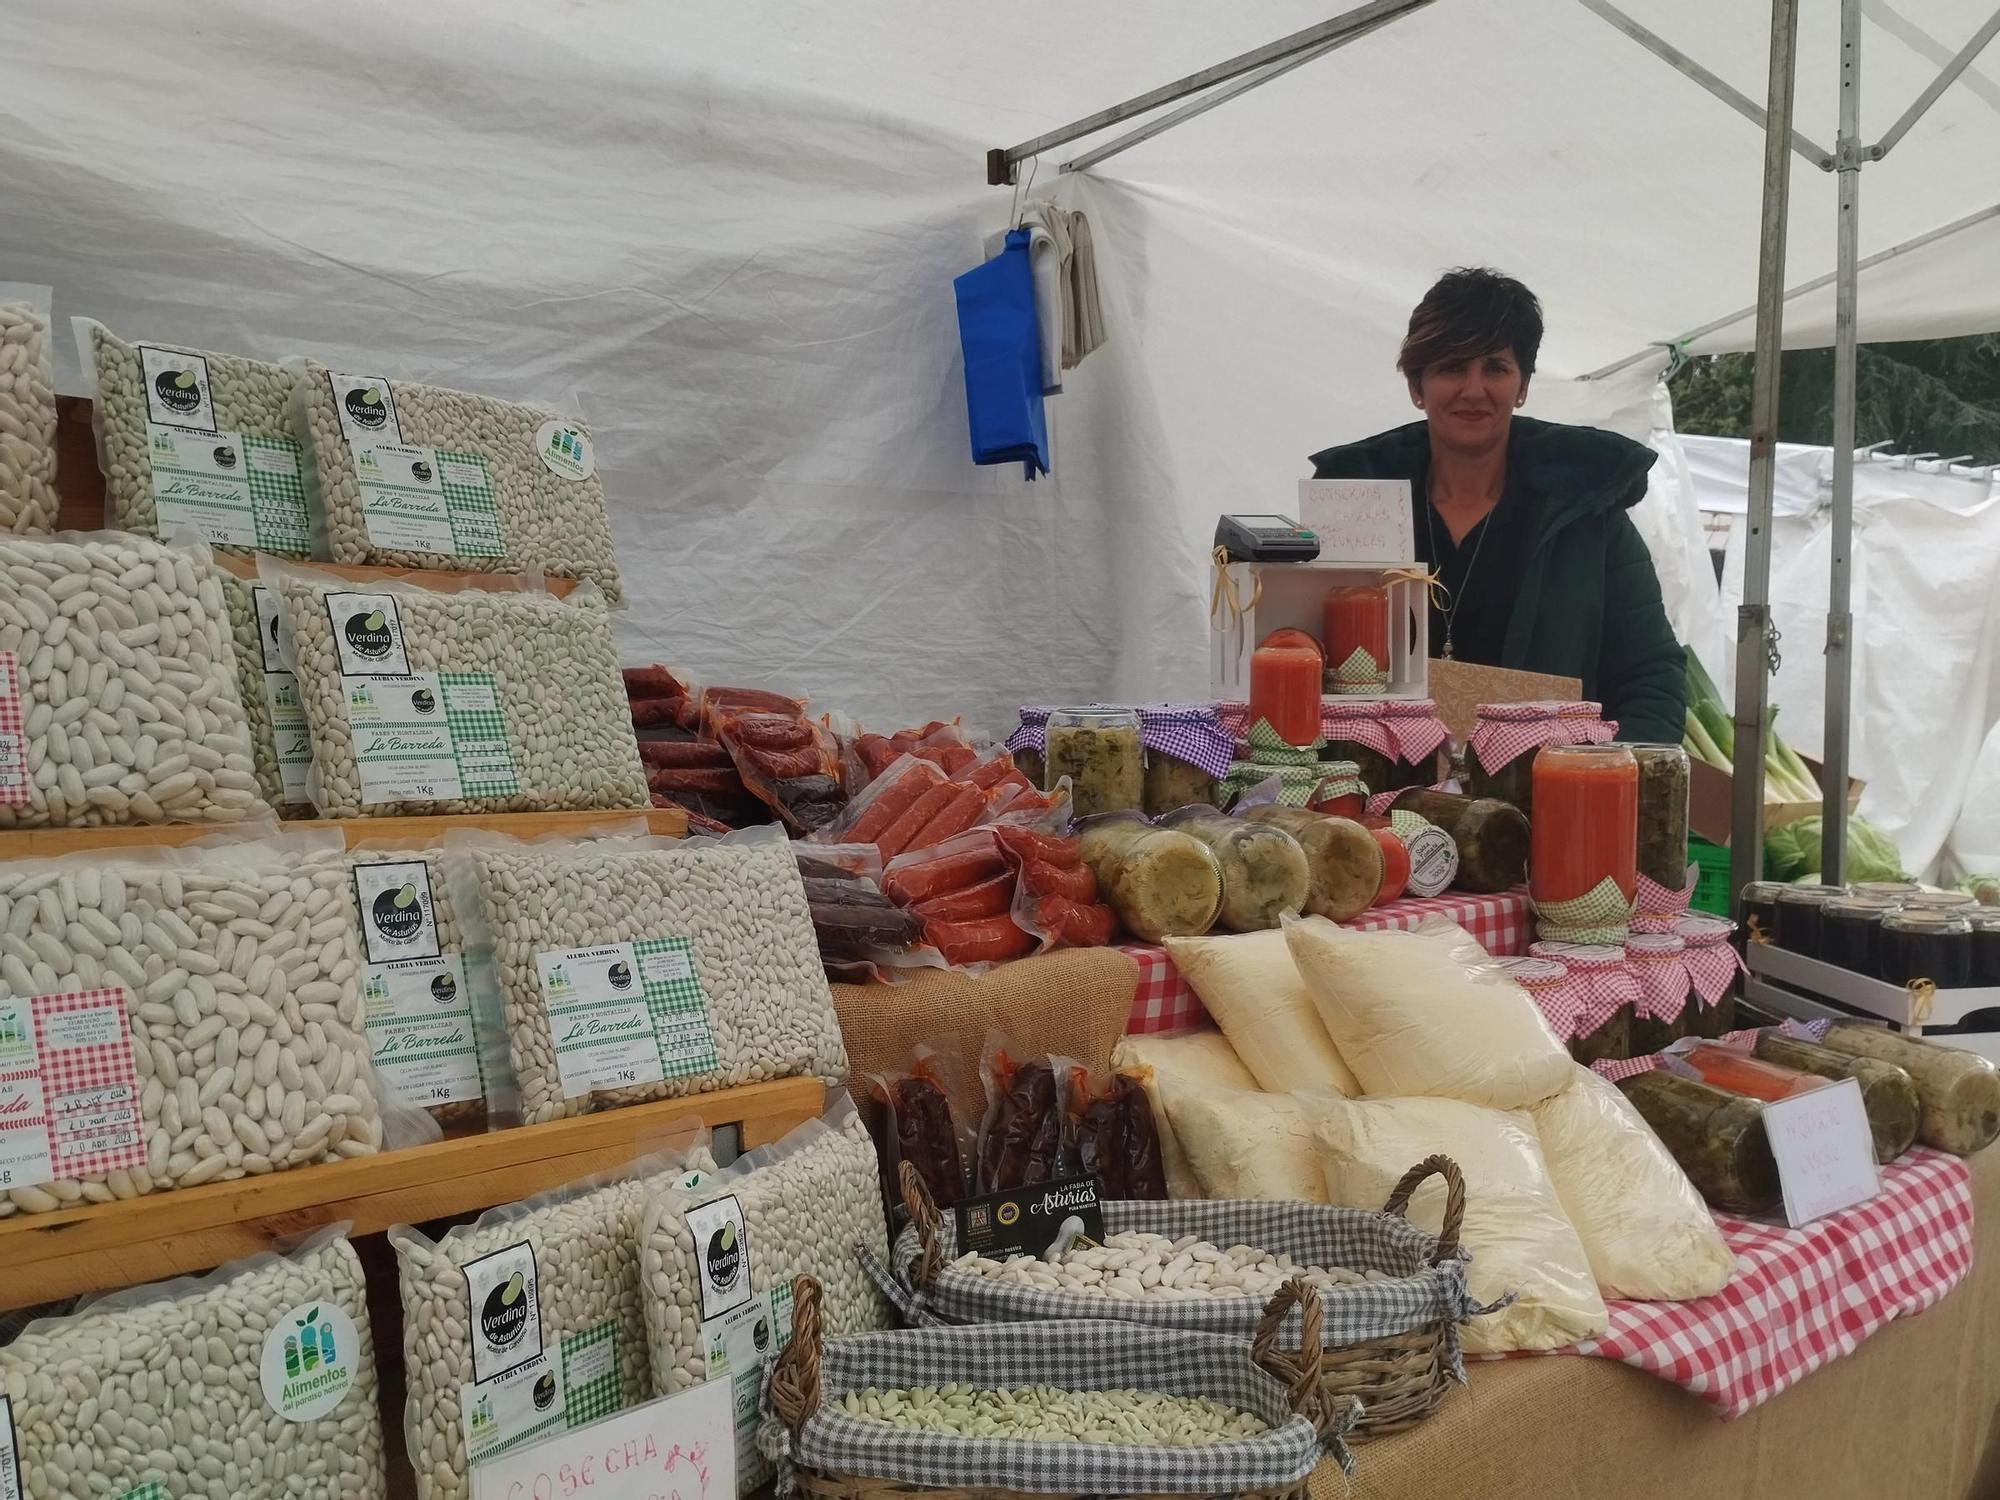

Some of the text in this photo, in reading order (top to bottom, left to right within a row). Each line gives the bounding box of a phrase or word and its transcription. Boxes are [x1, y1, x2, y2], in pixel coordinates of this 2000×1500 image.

[157, 386, 199, 401] Verdina
[347, 404, 385, 416] Verdina
[544, 448, 584, 472] Alimentos
[161, 482, 244, 501] La Barreda
[369, 496, 441, 513] La Barreda
[210, 530, 229, 541] 1Kg
[415, 540, 431, 550] 1Kg
[348, 633, 390, 643] Verdina
[364, 645, 388, 654] Asturias
[363, 737, 446, 753] La Barreda
[415, 785, 434, 795] 1Kg
[376, 910, 420, 924] Verdina
[382, 923, 418, 937] de Asturias
[561, 1014, 645, 1043] La Barreda
[374, 1028, 465, 1056] La Barreda
[617, 1070, 636, 1081] 1Kg
[430, 1088, 450, 1098] 1Kg
[1030, 1187, 1096, 1215] Asturias
[709, 1252, 738, 1272] Verdina
[484, 1305, 525, 1332] Verdina
[498, 1321, 523, 1342] Asturias
[493, 1356, 548, 1385] ALUBIA VERDINA
[282, 1366, 347, 1402] Alimentos
[282, 1402, 294, 1412] del
[323, 1379, 348, 1395] natural
[507, 1433, 657, 1500] COSECHA
